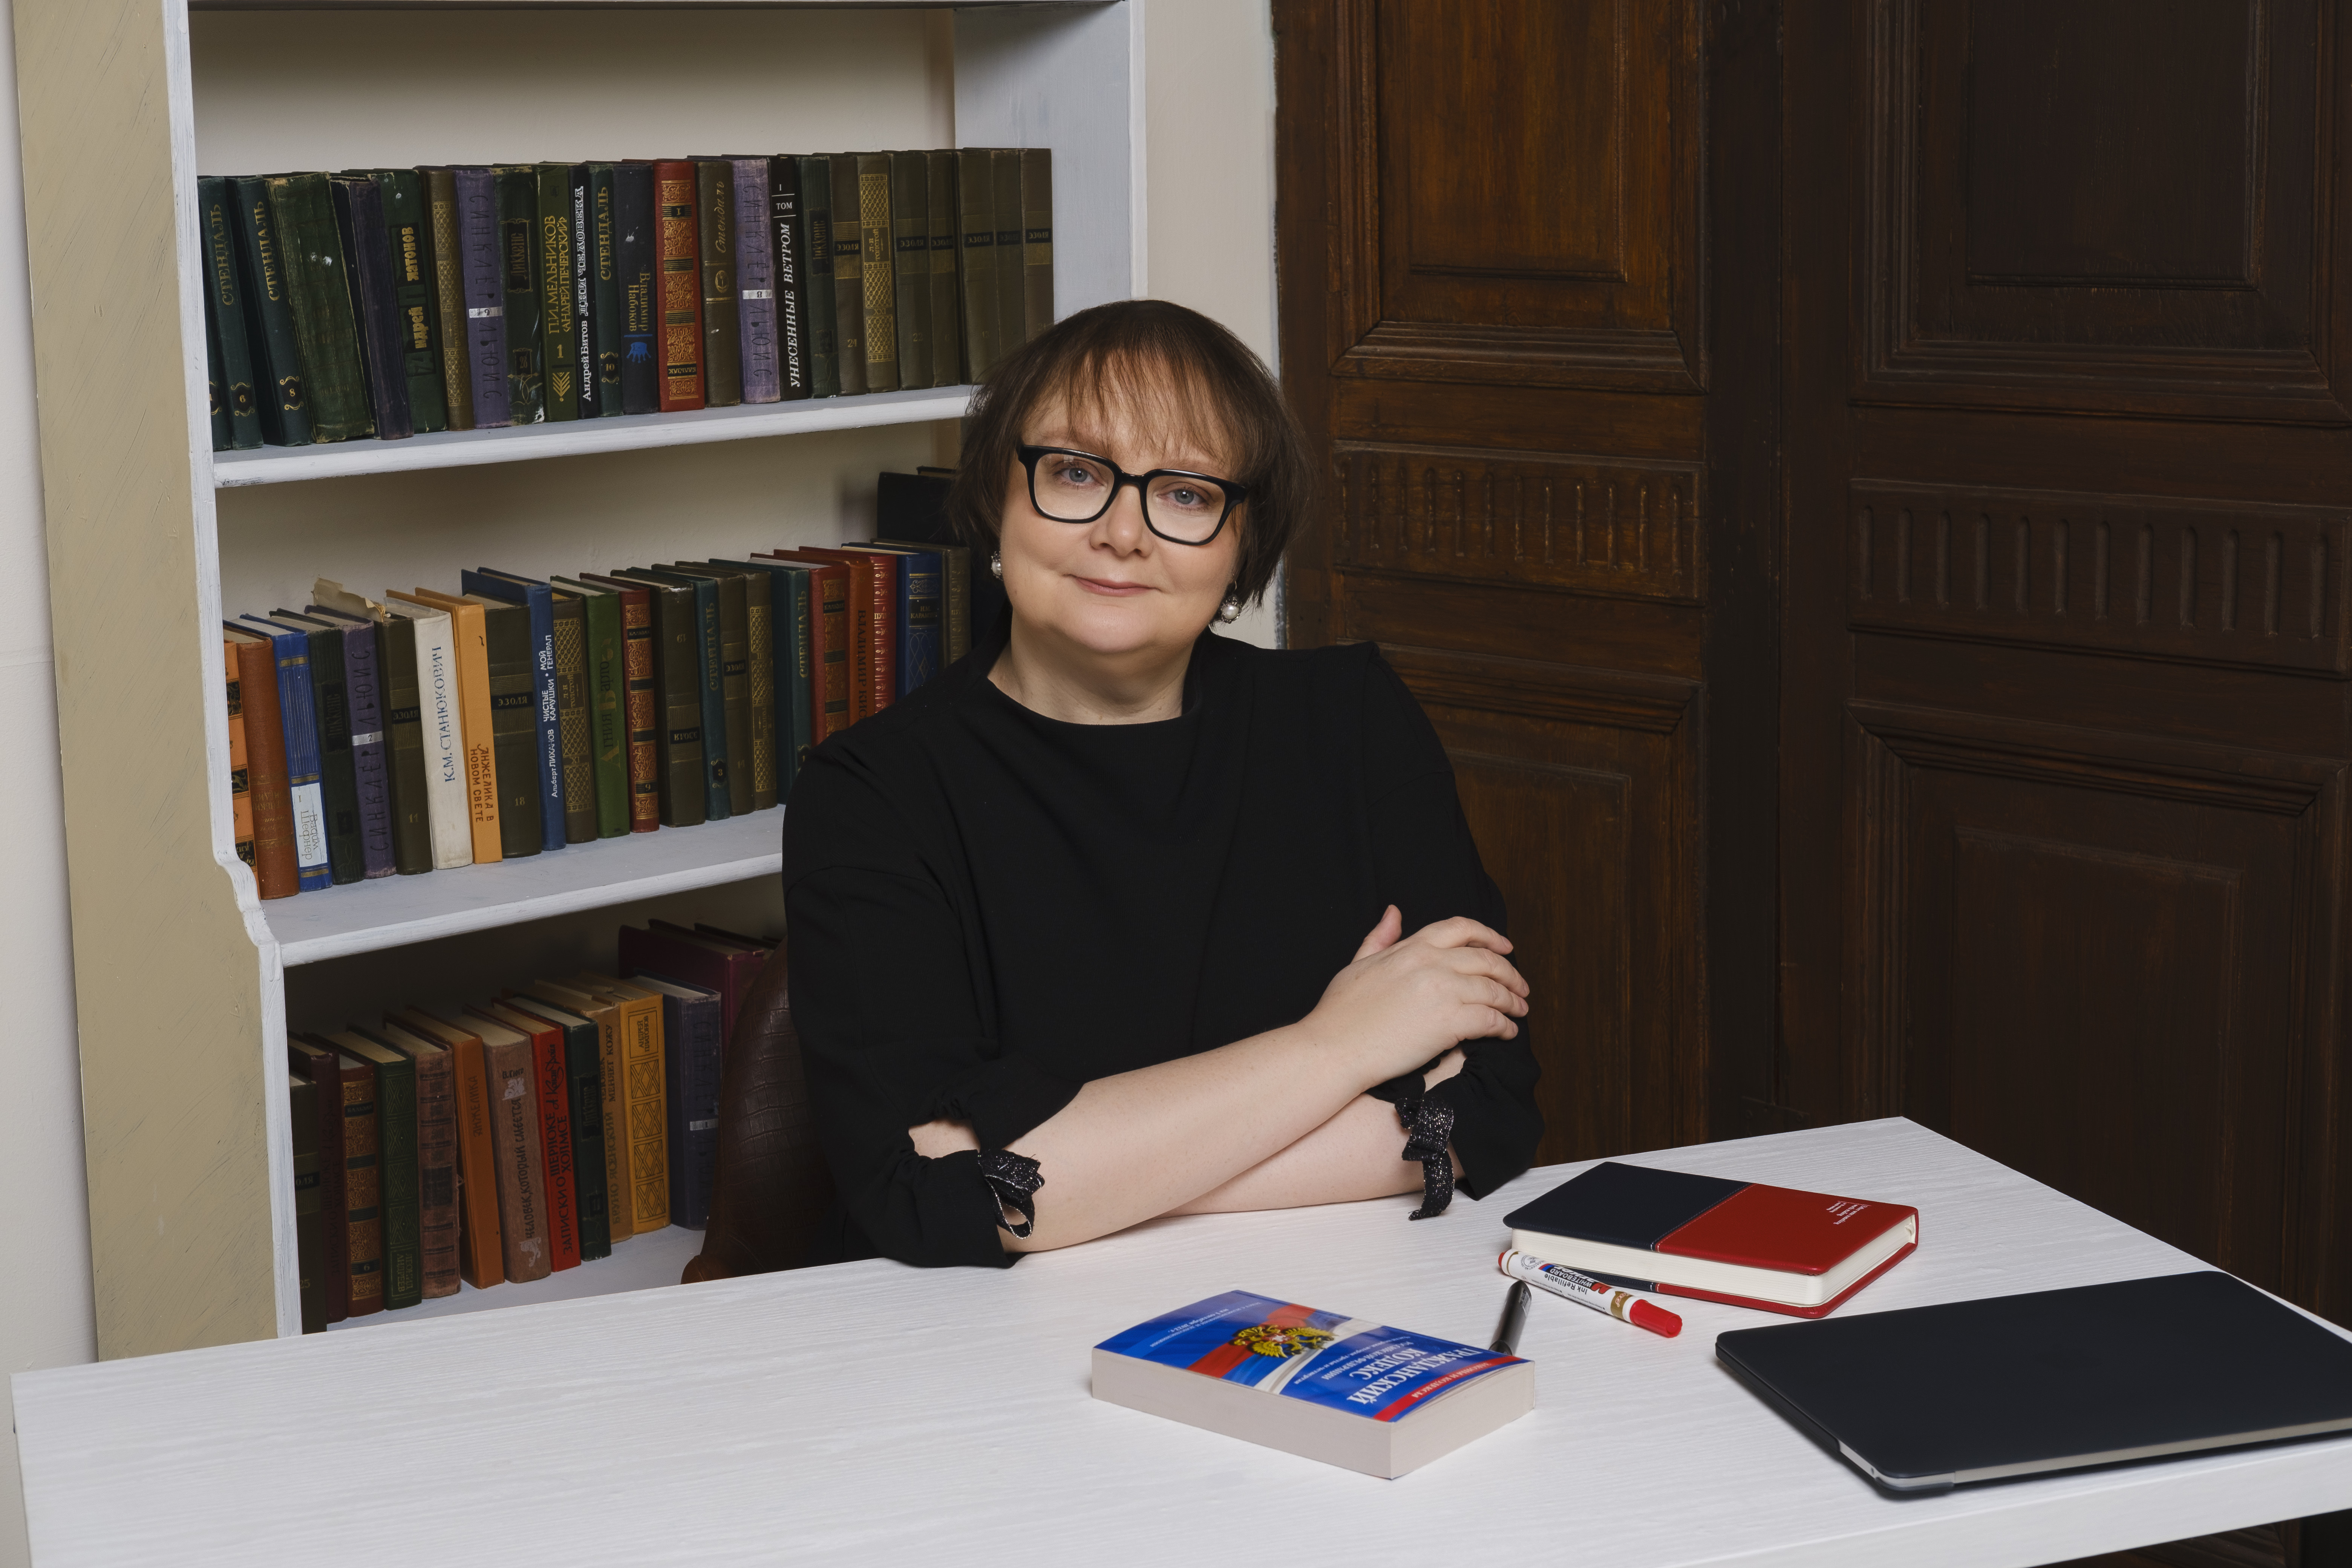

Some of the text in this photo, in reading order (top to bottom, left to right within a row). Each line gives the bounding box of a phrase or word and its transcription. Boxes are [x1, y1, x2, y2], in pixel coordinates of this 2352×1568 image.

[597, 186, 611, 280] СТЕНДАЛЬ
[714, 181, 726, 253] Стендаль
[872, 228, 880, 262] ТОЛСТОЙ
[210, 204, 234, 305] СТЕНДАЛЬ
[254, 201, 280, 301] СТЕНДАЛЬ
[510, 232, 528, 280] Диккенс
[544, 215, 558, 304] МЕЛЬНИКОВ
[469, 195, 502, 400] СИНКЛЕР ЛЬЮИС
[574, 186, 591, 401] Андрей Битов ДНИ ЧЕЛОВЕКА
[628, 284, 640, 332] Набоков
[638, 272, 651, 331] Владимир
[743, 185, 772, 377] СИНКЛЕР ЛЬЮИС
[780, 223, 801, 387] УНЕСЕННЫЕ ВЕТРОМ
[519, 356, 528, 369] 28
[557, 344, 564, 358] 1
[605, 363, 615, 372] 10
[240, 395, 246, 403] 6
[289, 388, 296, 397] 8
[545, 634, 554, 669] ГЕНЕРАЛ
[706, 602, 718, 691] СТЕНДАЛЬ
[798, 590, 808, 678] СТЕНДАЛЬ
[858, 609, 867, 687] ВЛАДИМИР
[432, 646, 455, 783] К.М. СТАНЮКОВИЧ
[498, 696, 528, 706] Э.ЗОЛЯ
[542, 690, 550, 723] ЧИСТЫЕ
[547, 678, 556, 721] КАМУШКИ
[567, 673, 576, 708] ТОЛСТОЙ
[598, 661, 621, 772] Агния Барто
[351, 651, 389, 851] СИНКЛЕР ЛЬЮИС
[478, 744, 493, 809] АНЖЕЛИКА
[718, 768, 723, 776] 3
[470, 749, 483, 823] НОВОМ СВЕТЕ
[514, 796, 525, 806] 18
[300, 810, 313, 860] Шефнер
[309, 812, 318, 850] Вадим
[606, 1023, 614, 1056] КОЖУ
[637, 1020, 645, 1049] АНДРЕЙ
[467, 1075, 482, 1138] АНЖЕЛИКА
[511, 1097, 527, 1144] СМЕЕТСЯ
[545, 1112, 561, 1178] ШЕРЛОКЕ
[557, 1115, 573, 1173] ХОЛМСЕ
[603, 1112, 620, 1225] БРУНО ЯСЕНСКИЙ
[556, 1176, 573, 1255] ЗАПИСКИ О
[1544, 1273, 1576, 1290] Refillable
[1550, 1268, 1592, 1287] WHITEBOARD
[1345, 1348, 1484, 1405] ГРАЖДАНСКИЙ
[1348, 1348, 1429, 1381] КОДЕКС
